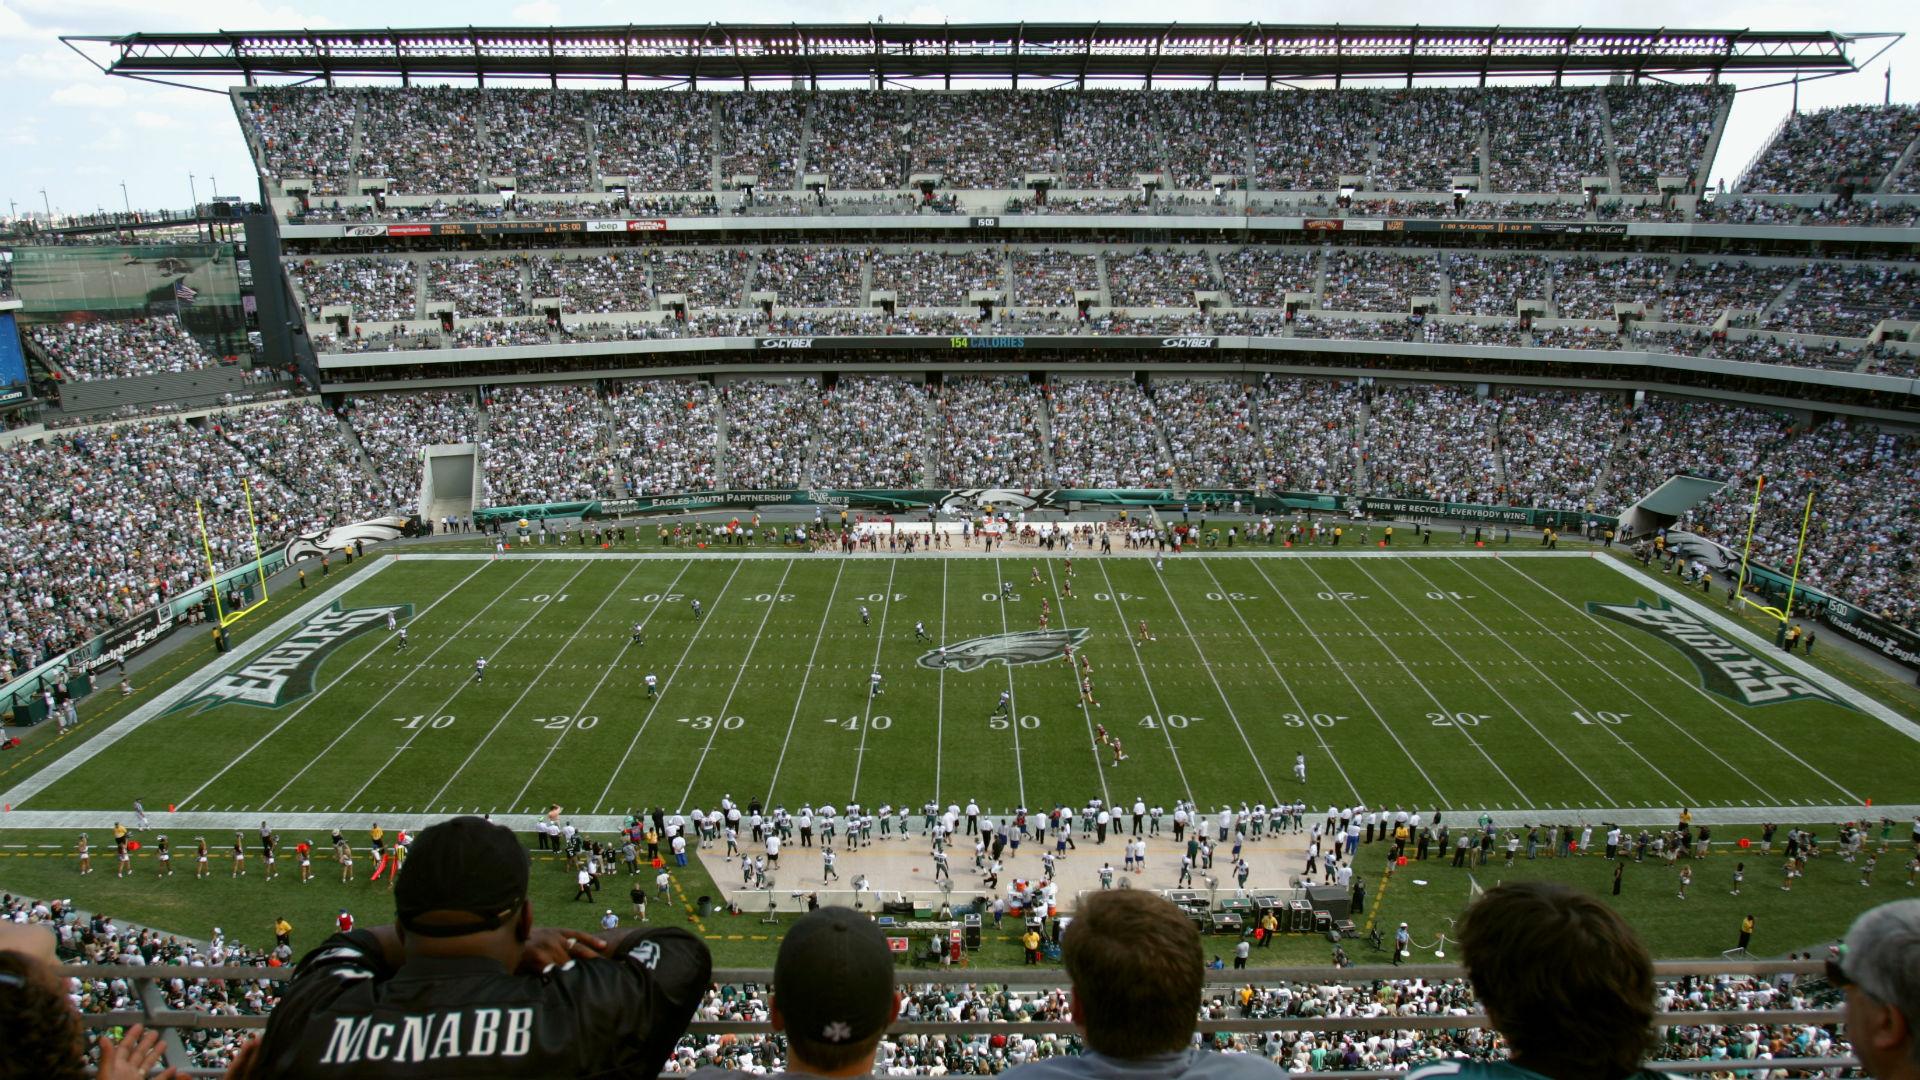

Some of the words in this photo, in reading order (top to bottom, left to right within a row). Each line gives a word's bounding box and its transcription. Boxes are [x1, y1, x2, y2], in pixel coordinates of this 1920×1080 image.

[560, 223, 581, 231] 15:00
[595, 221, 618, 230] Jeep
[778, 338, 815, 348] CYBEX
[950, 337, 968, 348] 154
[970, 337, 1024, 348] CALORIES
[1177, 338, 1214, 348] CYBEX
[1366, 502, 1391, 511] WHEN
[1393, 504, 1407, 512] WE
[1451, 508, 1500, 518] EVERYBODY
[135, 619, 172, 647] Eagles
[189, 604, 402, 704] EAGLES
[1599, 605, 1836, 703] EAGLES
[1883, 636, 1920, 665] Eagle
